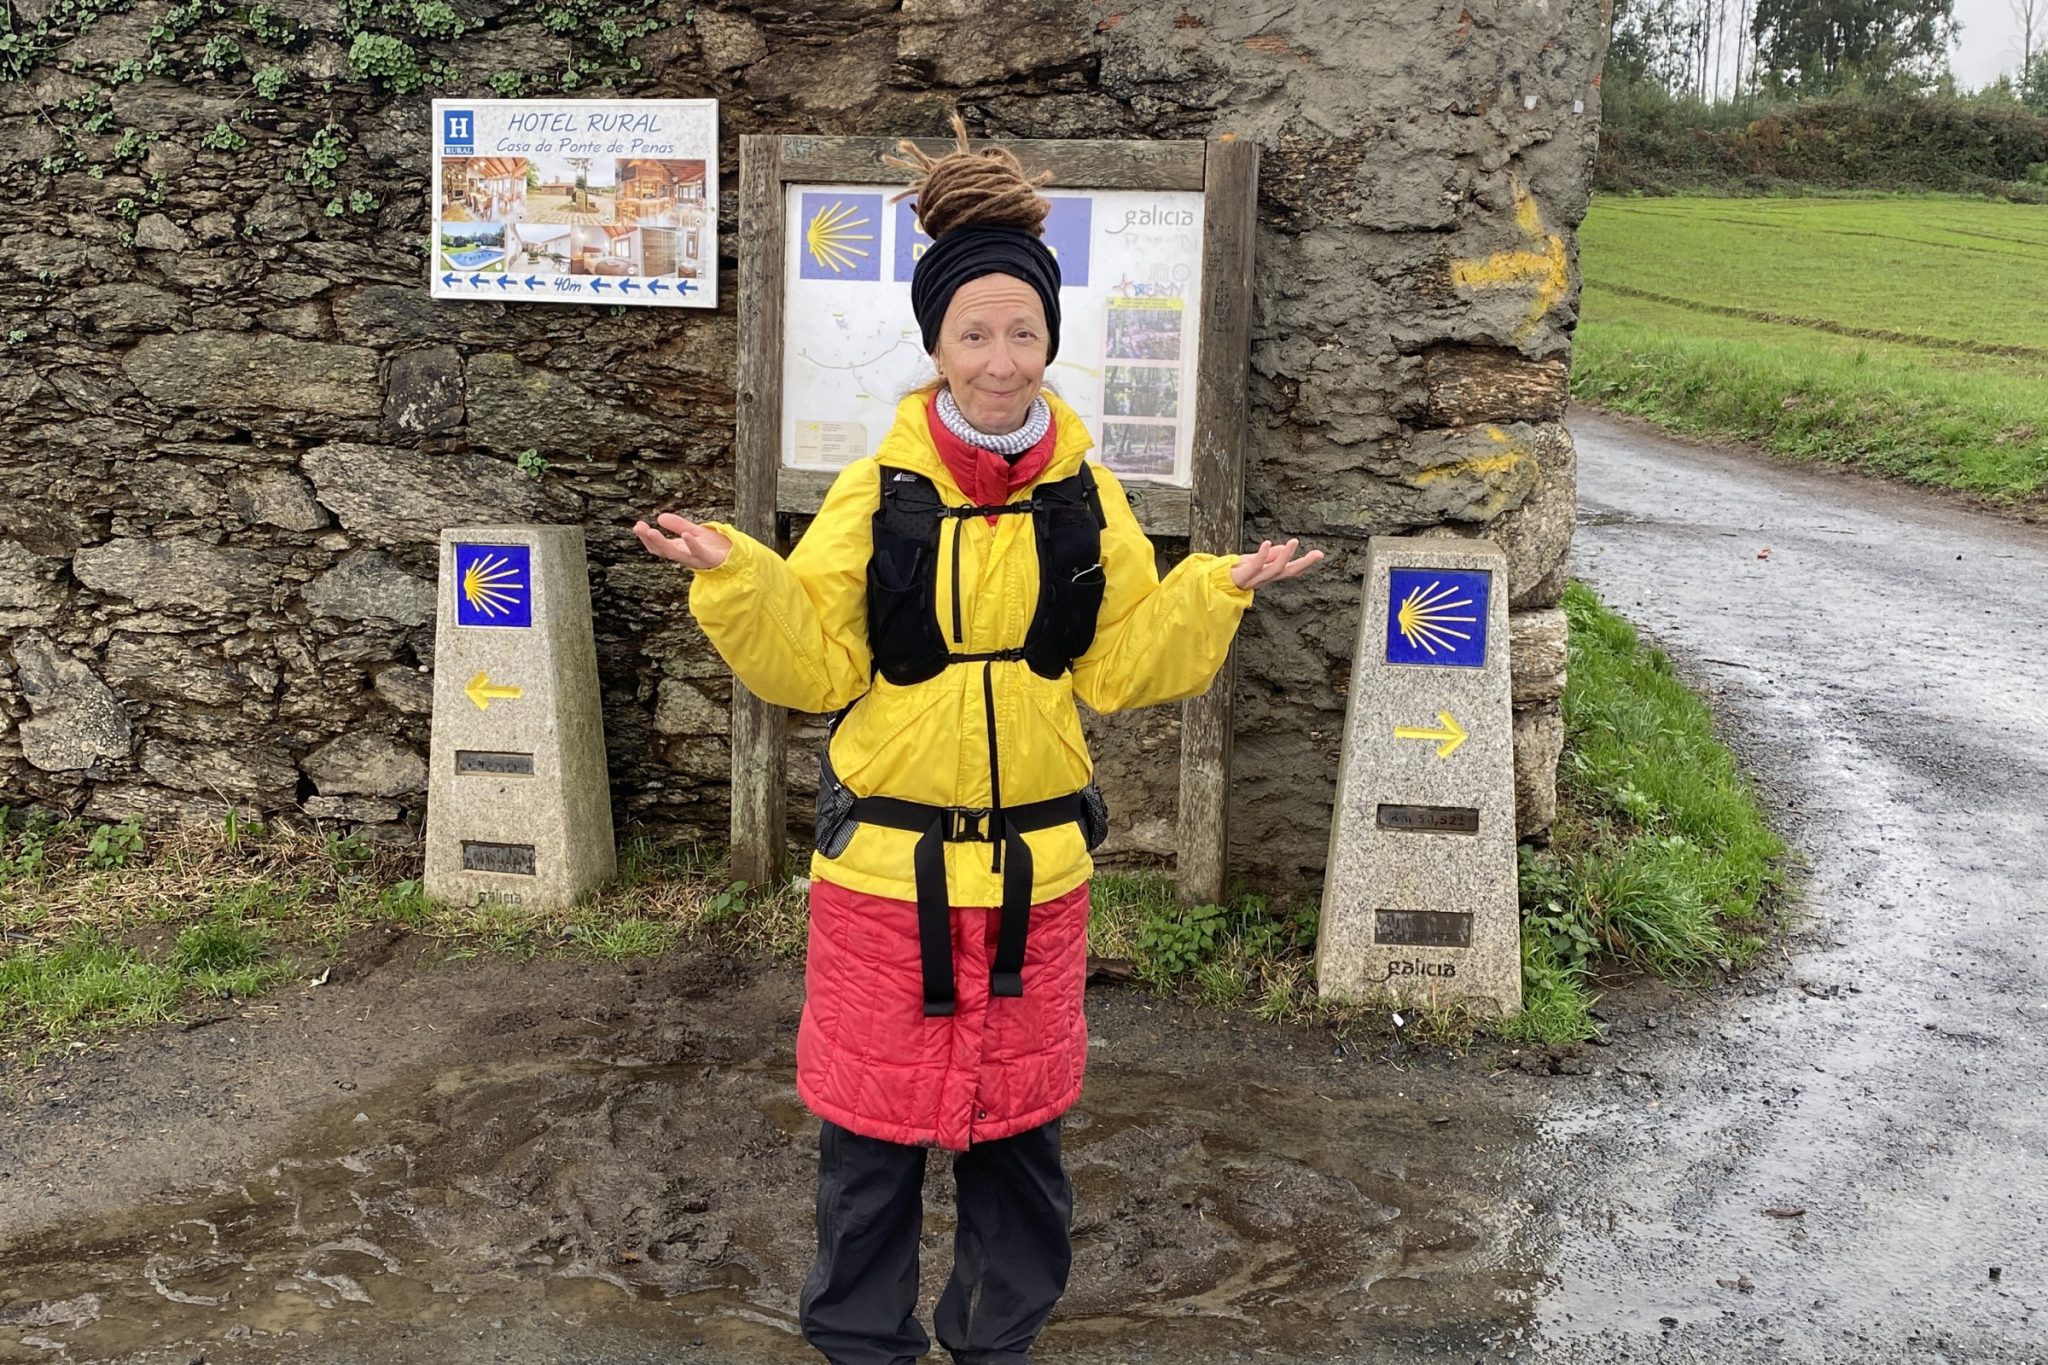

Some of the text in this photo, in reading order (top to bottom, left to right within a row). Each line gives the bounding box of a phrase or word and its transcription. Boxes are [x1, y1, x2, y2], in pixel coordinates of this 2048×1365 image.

[449, 118, 469, 138] H
[508, 113, 662, 132] HOTEL RURAL
[496, 137, 674, 154] Casa da Ponte de Penas
[1104, 204, 1195, 235] galicia
[554, 277, 582, 294] 40m
[1367, 957, 1457, 983] galicia
